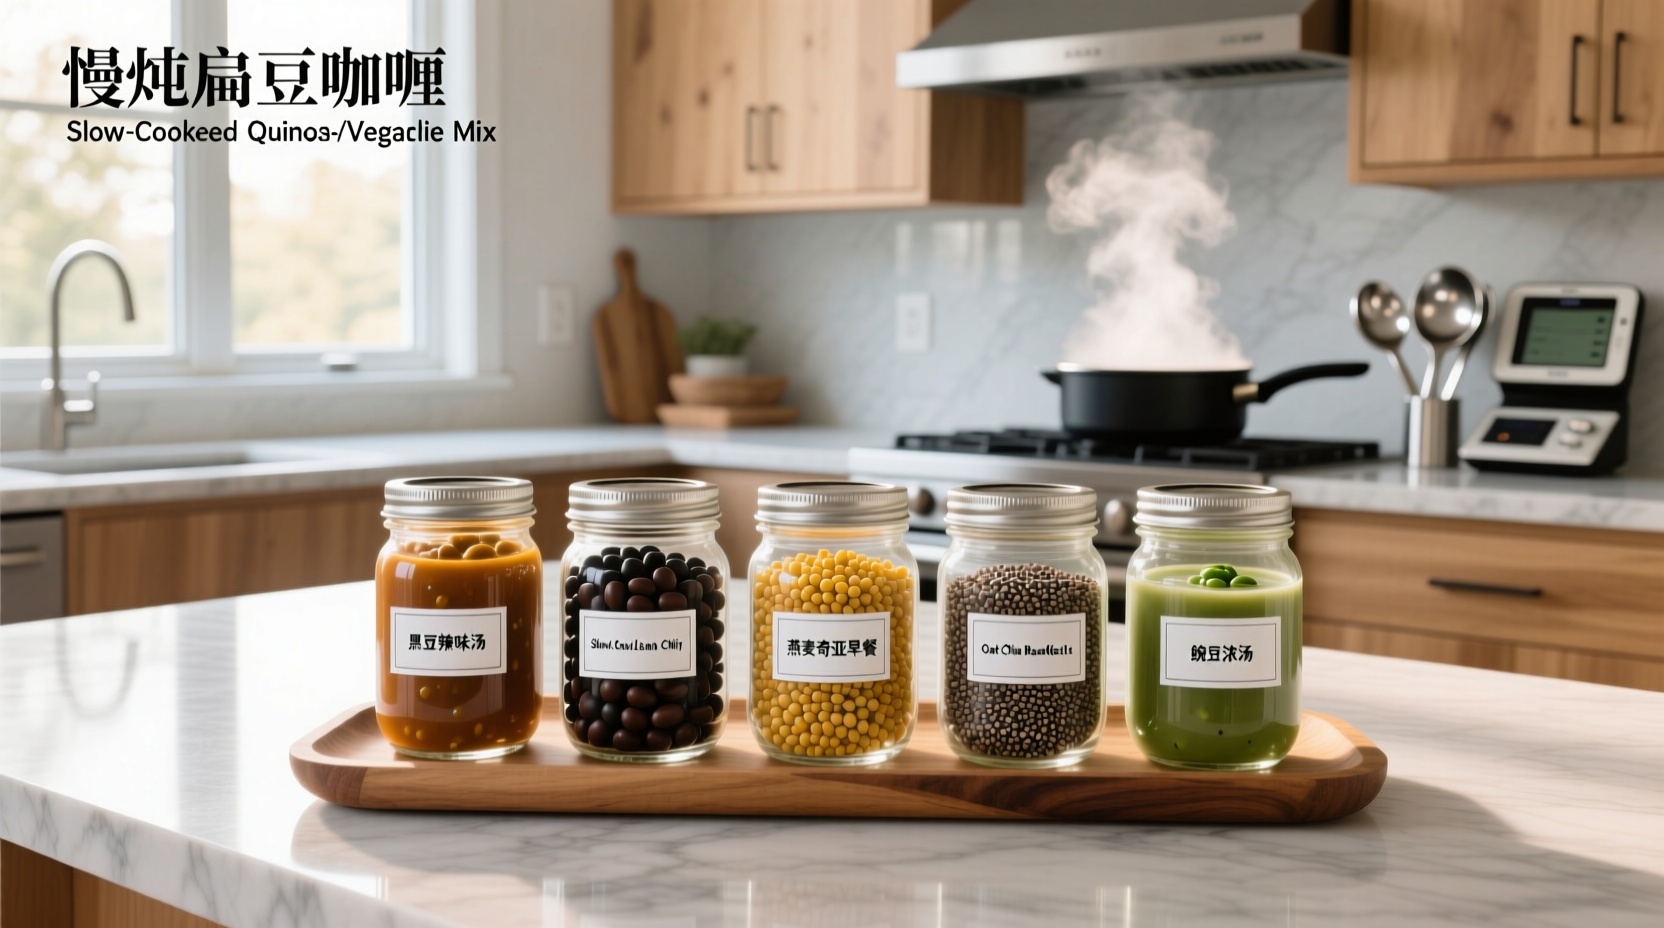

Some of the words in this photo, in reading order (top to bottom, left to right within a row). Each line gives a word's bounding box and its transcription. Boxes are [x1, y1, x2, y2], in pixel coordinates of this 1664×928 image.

[786, 638, 878, 658] 燕麦奇亚早餐
